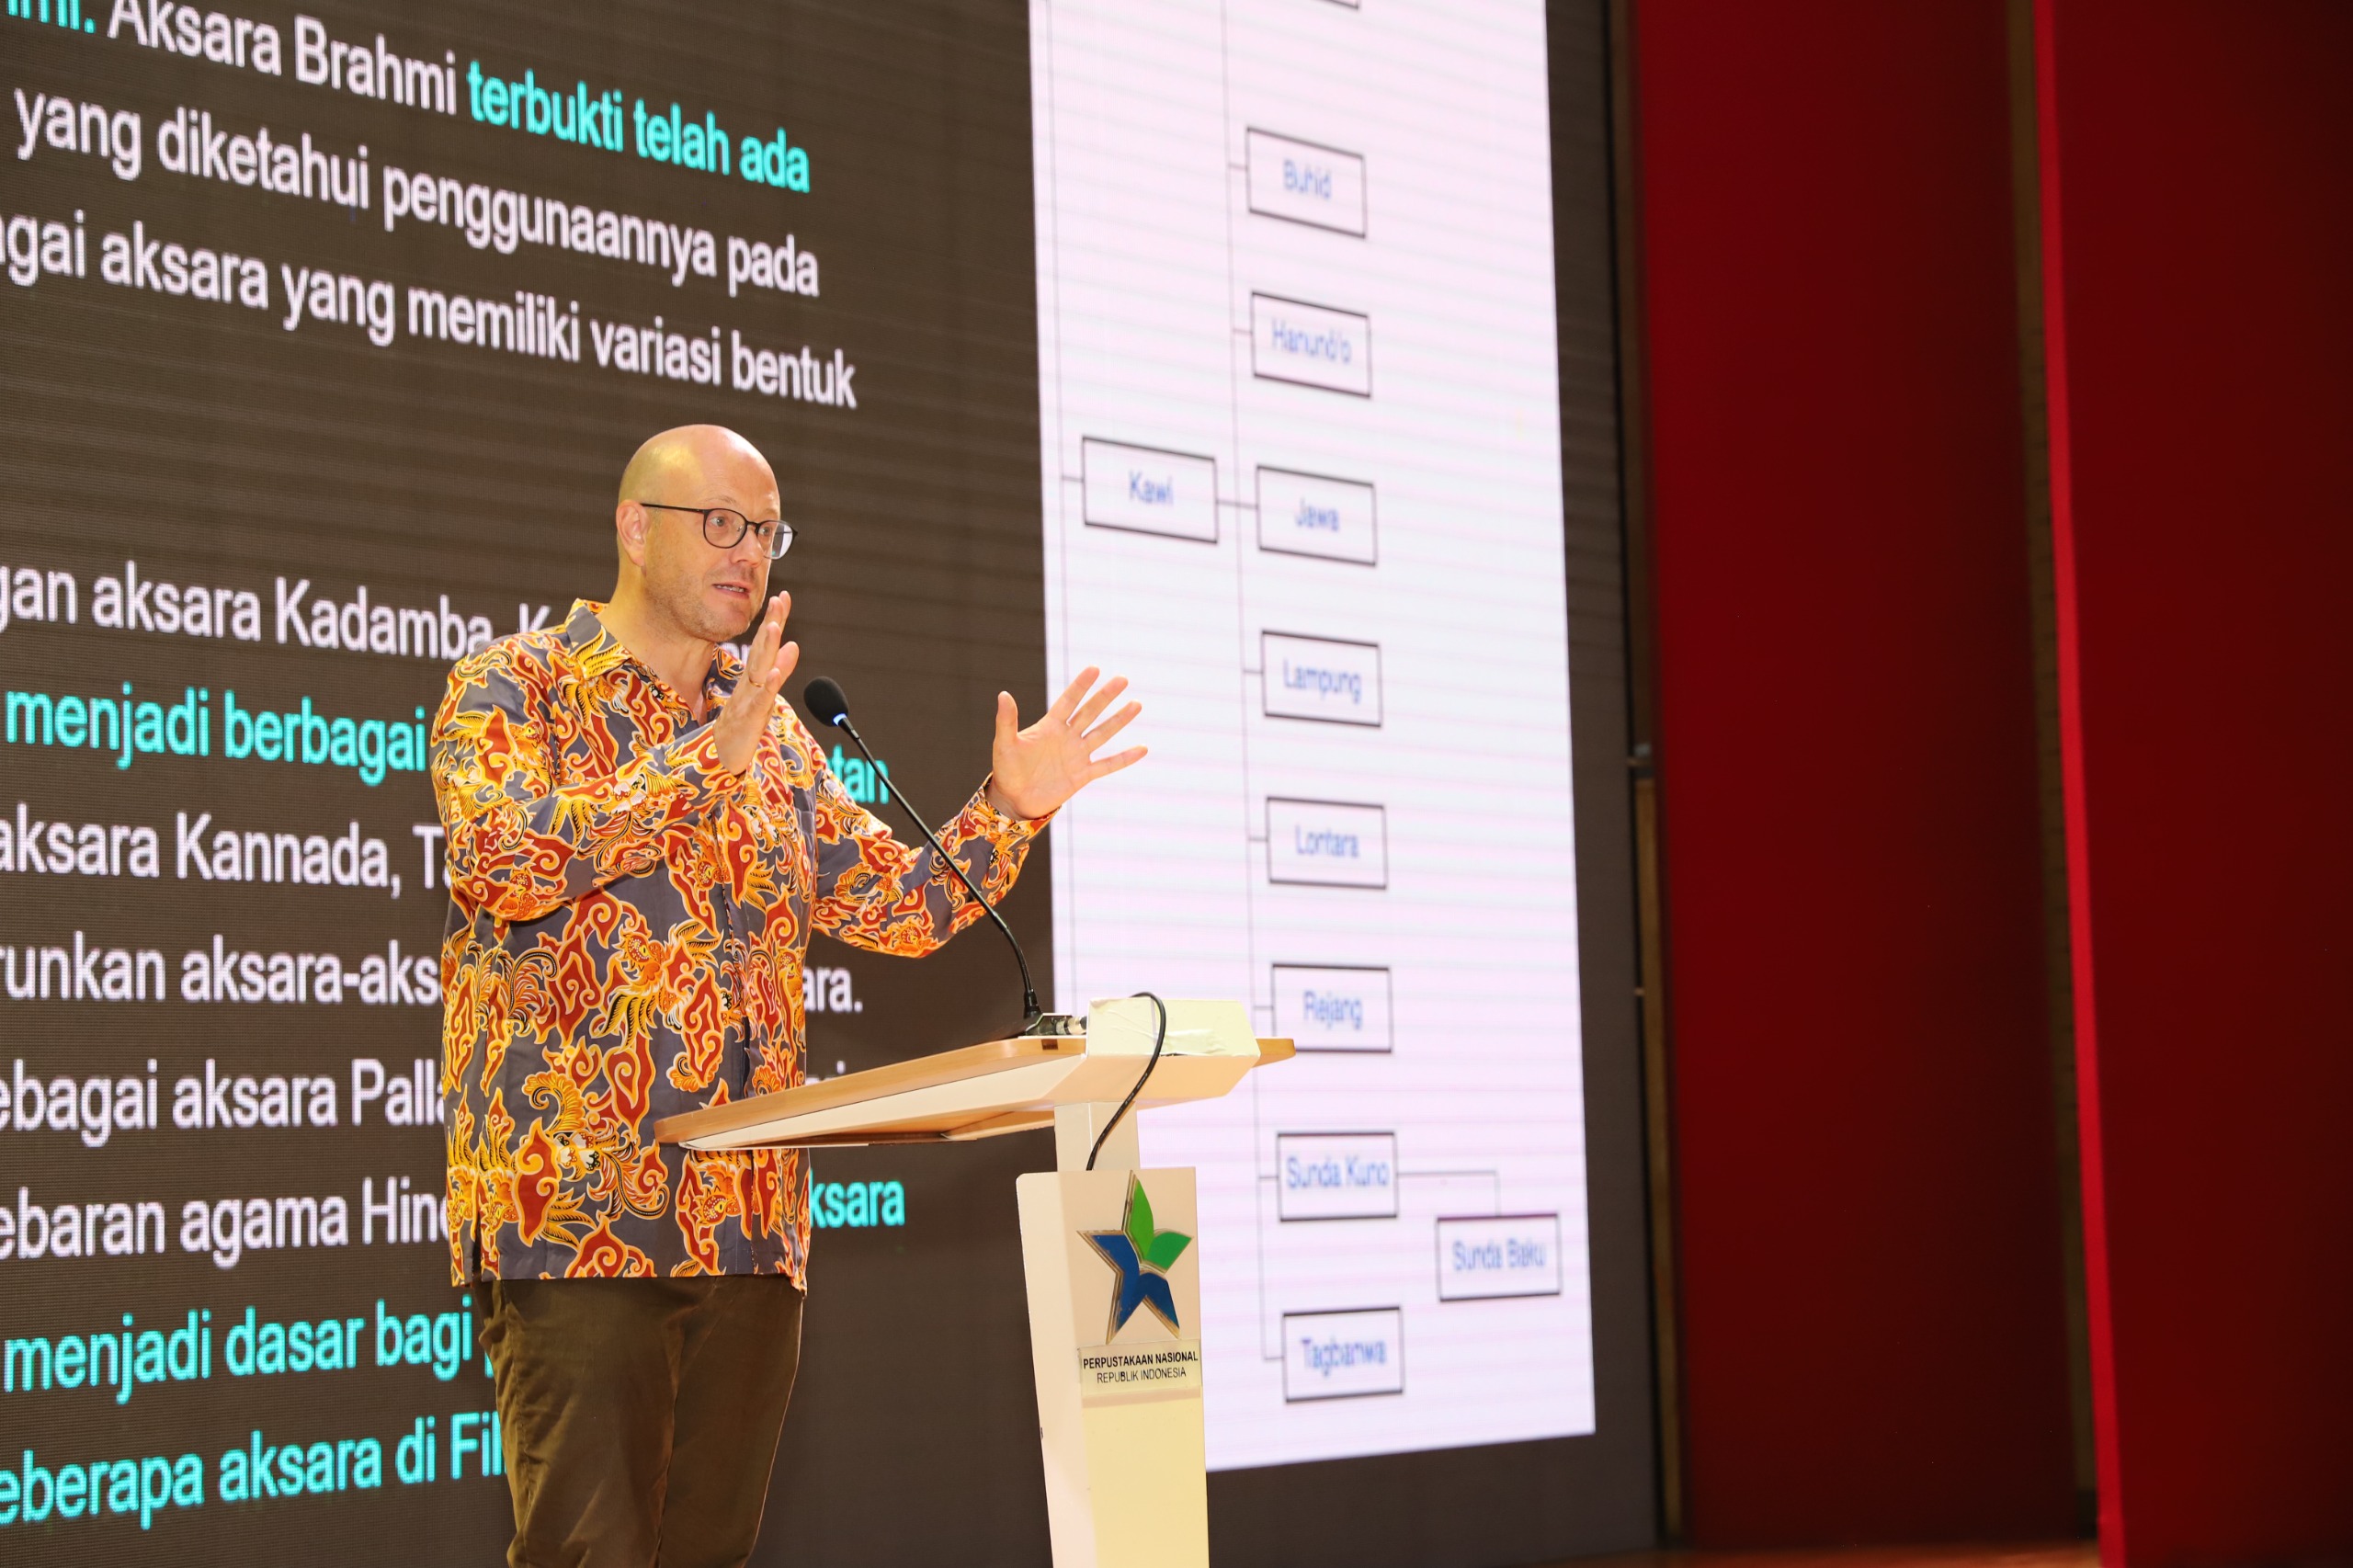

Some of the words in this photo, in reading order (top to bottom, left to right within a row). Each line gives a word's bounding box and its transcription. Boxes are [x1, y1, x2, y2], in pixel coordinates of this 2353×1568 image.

[108, 0, 282, 76] Aksara
[296, 17, 457, 116] Brahmi
[467, 62, 624, 153] terbukti
[634, 100, 731, 176] telah
[740, 130, 811, 194] ada
[16, 90, 142, 181] yang
[159, 108, 369, 210] diketahui
[382, 165, 716, 287] penggunaannya
[730, 235, 820, 298] pada
[1283, 159, 1332, 199] Buhid
[0, 210, 85, 287] gai
[102, 222, 269, 309] aksara
[283, 265, 396, 347] yang
[408, 289, 580, 362] memiliki
[590, 316, 721, 386] variasi
[733, 331, 857, 409] bentuk
[1129, 471, 1174, 506] Kawi
[1294, 498, 1341, 532] Jawa
[93, 562, 262, 642] aksara
[1283, 660, 1363, 705] Lampung
[6, 683, 210, 771] menjadi
[225, 691, 426, 787] berbagai
[826, 744, 889, 804] tan
[178, 813, 401, 899] Kannada,
[1296, 825, 1360, 858] Lontara
[0, 932, 166, 1001] unkan
[182, 936, 442, 1005] aksara-aks
[1303, 991, 1363, 1031] Rejang
[174, 1060, 338, 1129] aksara
[353, 1060, 444, 1126] Pall
[1287, 1156, 1342, 1189] Sunda
[1346, 1154, 1390, 1187] Kuno
[181, 1198, 349, 1269] agama
[362, 1176, 449, 1245] Hin
[1452, 1240, 1502, 1271] Sunda
[1508, 1238, 1547, 1268] Baku
[4, 1312, 212, 1404] menjadi
[226, 1307, 365, 1377] dasar
[378, 1296, 472, 1381] bagi
[1083, 1354, 1154, 1369] PERPUSTAKAAN
[1155, 1351, 1199, 1364] NASIONAL
[1097, 1370, 1139, 1383] REPUBLIK
[1141, 1367, 1187, 1381] INDONESIA
[1301, 1335, 1388, 1378] Tagbanwa
[0, 1451, 205, 1530] eberapa
[221, 1431, 382, 1502] aksara
[396, 1417, 436, 1484] di
[451, 1412, 506, 1480] Fil
